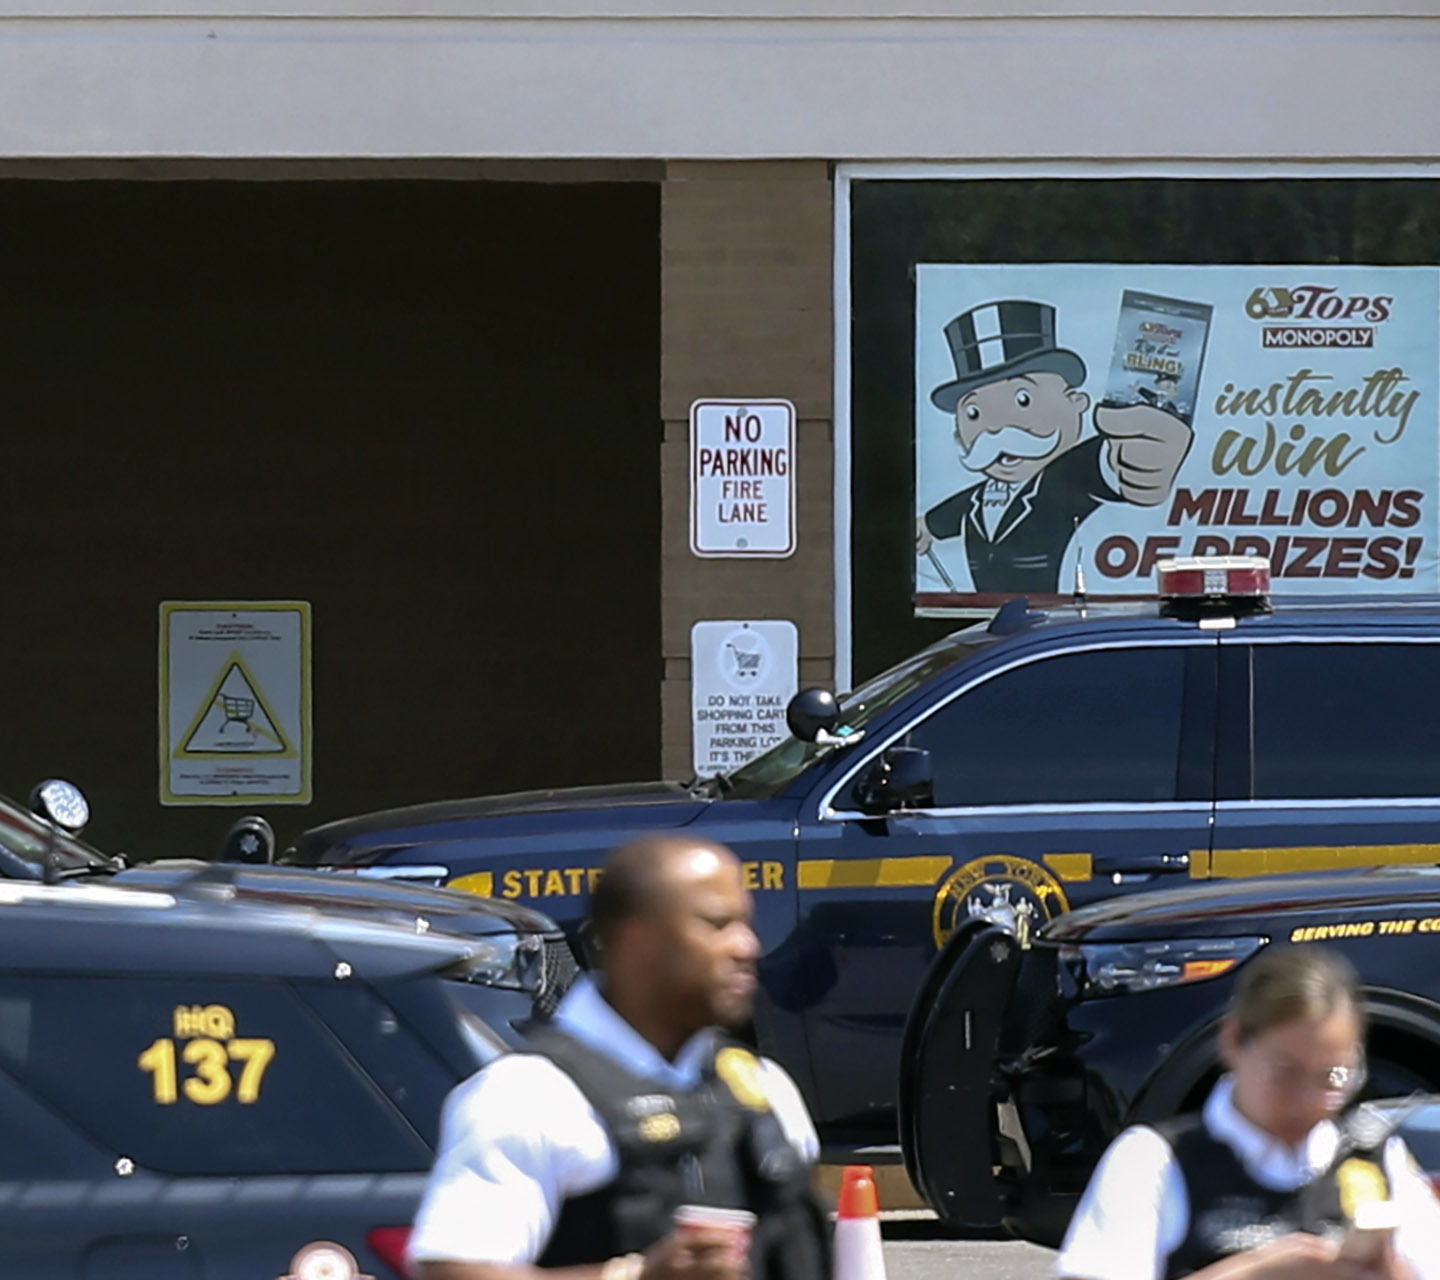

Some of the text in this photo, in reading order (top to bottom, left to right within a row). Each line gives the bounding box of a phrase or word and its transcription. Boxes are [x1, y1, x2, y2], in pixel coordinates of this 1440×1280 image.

[1291, 285, 1394, 322] TOPS
[1265, 329, 1371, 346] MONOPOLY
[1217, 367, 1421, 444] instantly
[725, 415, 761, 442] NO
[700, 448, 787, 477] PARKING
[723, 480, 763, 499] FIRE
[719, 503, 768, 522] LANE
[1168, 489, 1423, 527] MILLIONS
[1095, 535, 1180, 578] OF
[708, 696, 782, 706] DO NOT TAKE
[697, 709, 786, 720] SHOPPING CART
[715, 723, 776, 734] FROM THIS
[709, 737, 757, 748] PARKING
[709, 751, 729, 762] IT'S
[1291, 921, 1375, 943] SERVING
[1378, 919, 1416, 935] THE
[174, 1004, 235, 1039] HQ
[139, 1037, 276, 1105] 137
